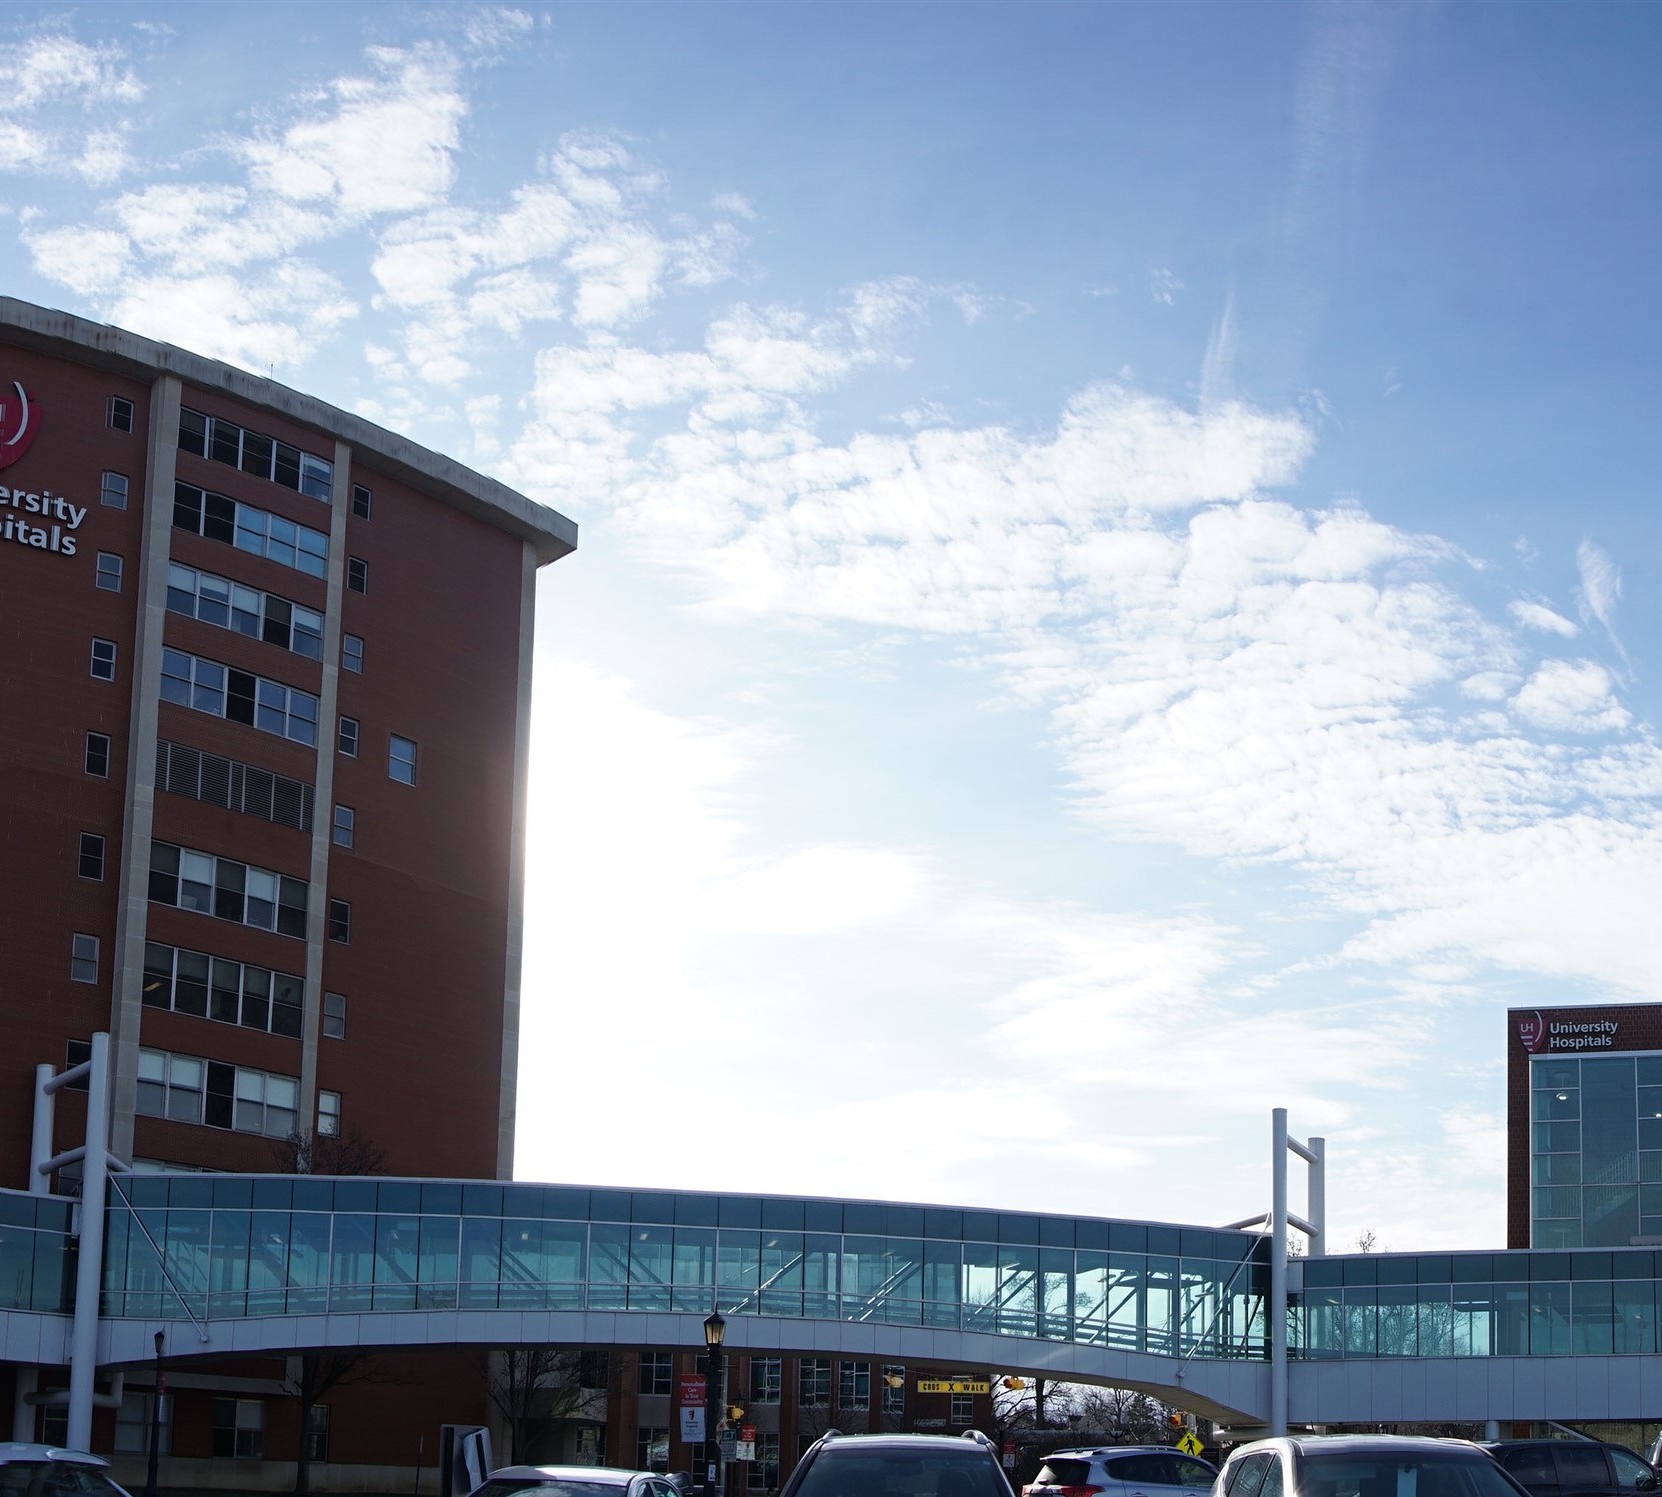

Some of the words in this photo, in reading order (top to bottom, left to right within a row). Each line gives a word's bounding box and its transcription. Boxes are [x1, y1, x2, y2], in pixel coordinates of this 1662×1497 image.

[1520, 1023, 1533, 1033] UH
[1549, 1020, 1618, 1034] University
[1549, 1034, 1612, 1050] Hospitals
[922, 1383, 942, 1391] CROS
[948, 1383, 955, 1391] X
[963, 1384, 984, 1392] WALK
